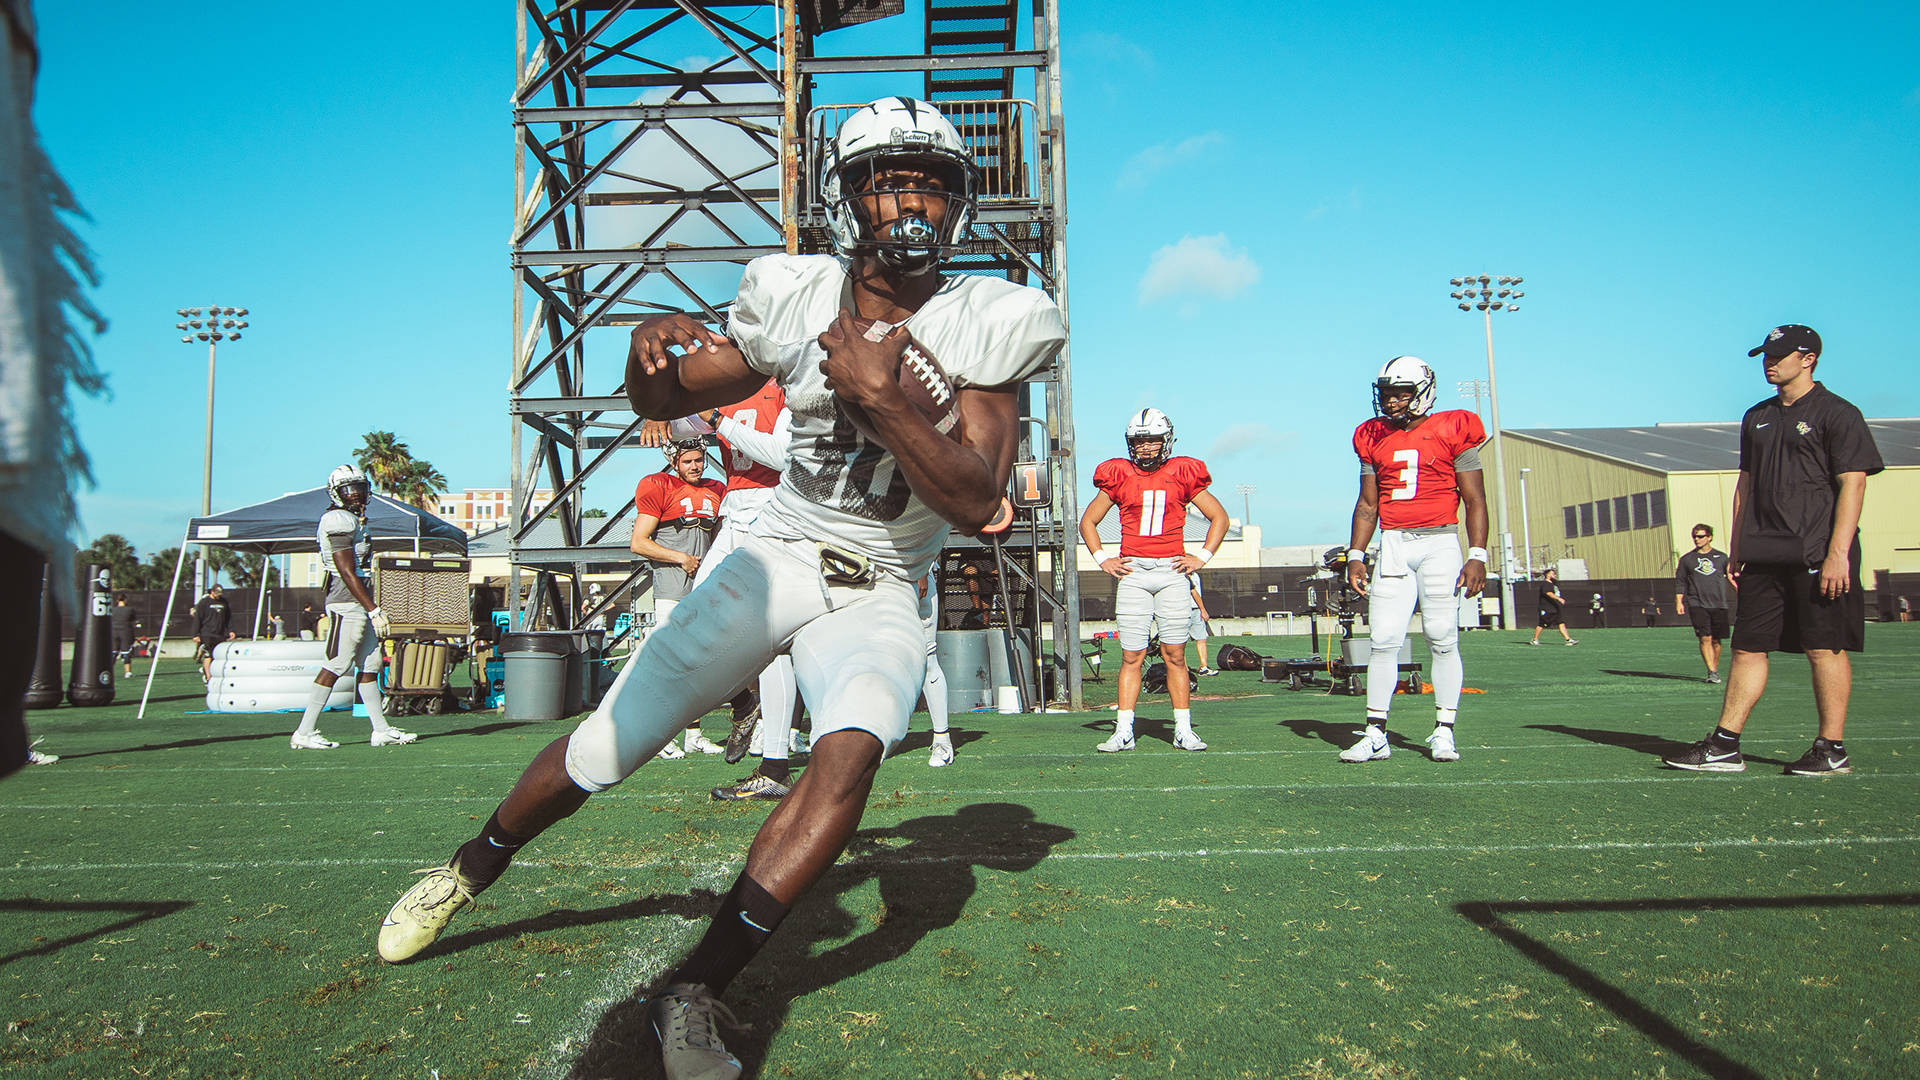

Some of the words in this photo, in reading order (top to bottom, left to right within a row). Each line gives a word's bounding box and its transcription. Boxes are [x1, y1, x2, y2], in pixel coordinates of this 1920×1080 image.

[1023, 466, 1041, 501] 1
[1391, 449, 1420, 501] 3
[1138, 489, 1167, 537] 11
